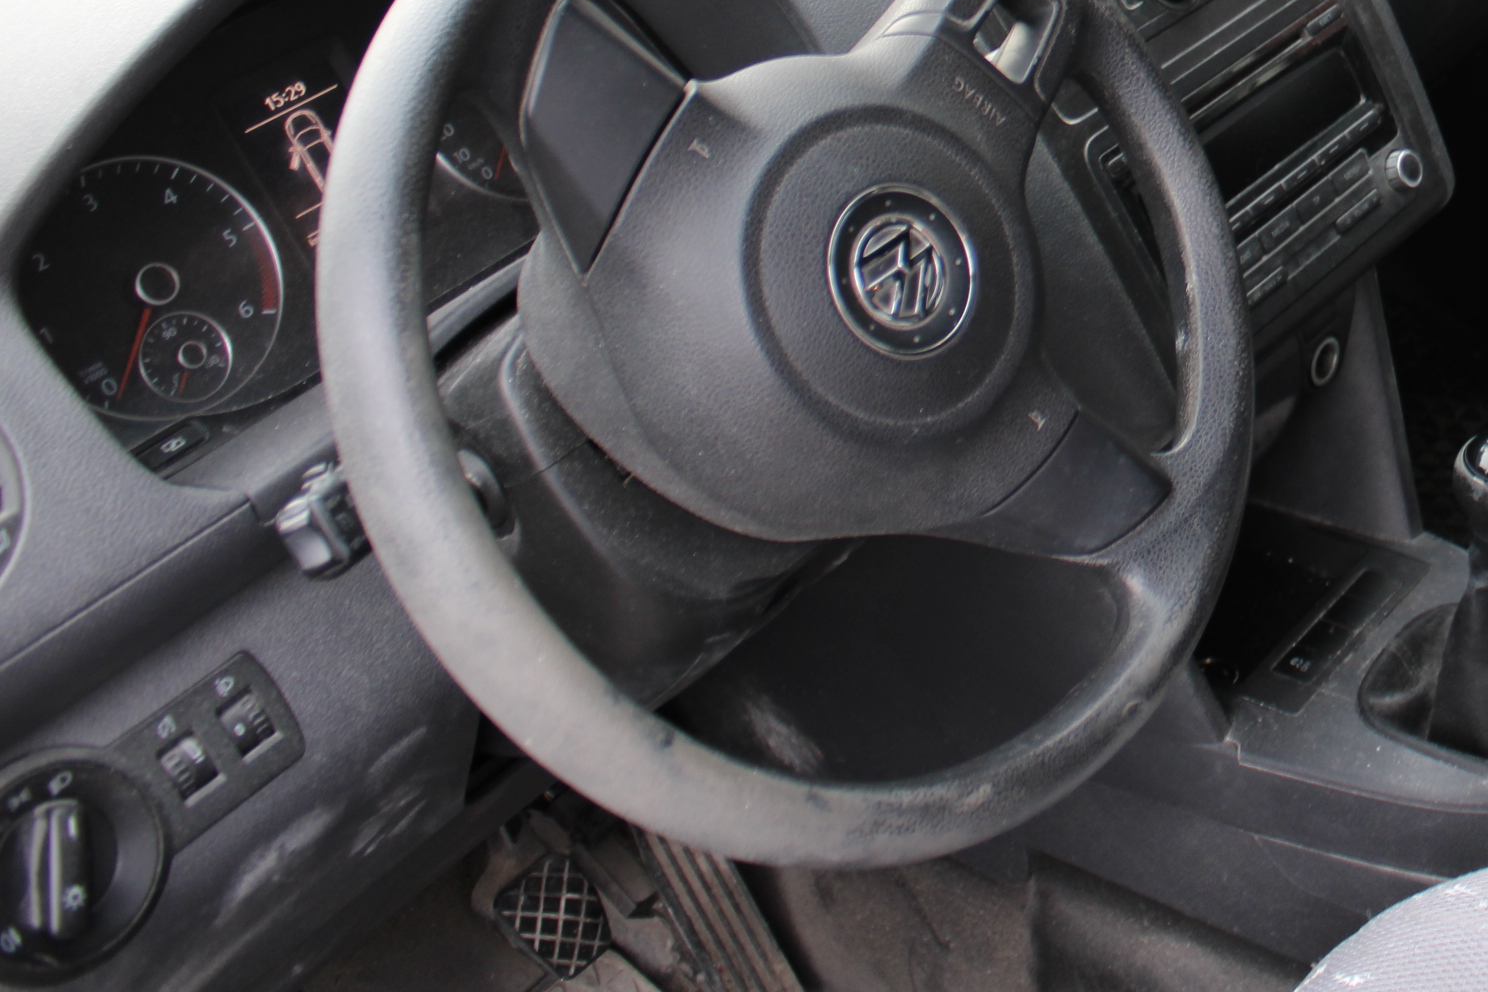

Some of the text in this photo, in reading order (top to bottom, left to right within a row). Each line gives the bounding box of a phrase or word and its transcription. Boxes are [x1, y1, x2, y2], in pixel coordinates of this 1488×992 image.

[264, 81, 307, 111] 15:29
[951, 75, 1006, 127] AIRBAG
[452, 147, 471, 164] 10
[83, 192, 98, 212] 3
[161, 187, 178, 206] 4
[222, 228, 238, 247] 5
[32, 253, 50, 272] 2
[238, 299, 255, 319] 6
[39, 327, 54, 344] 1
[101, 377, 118, 396] 0
